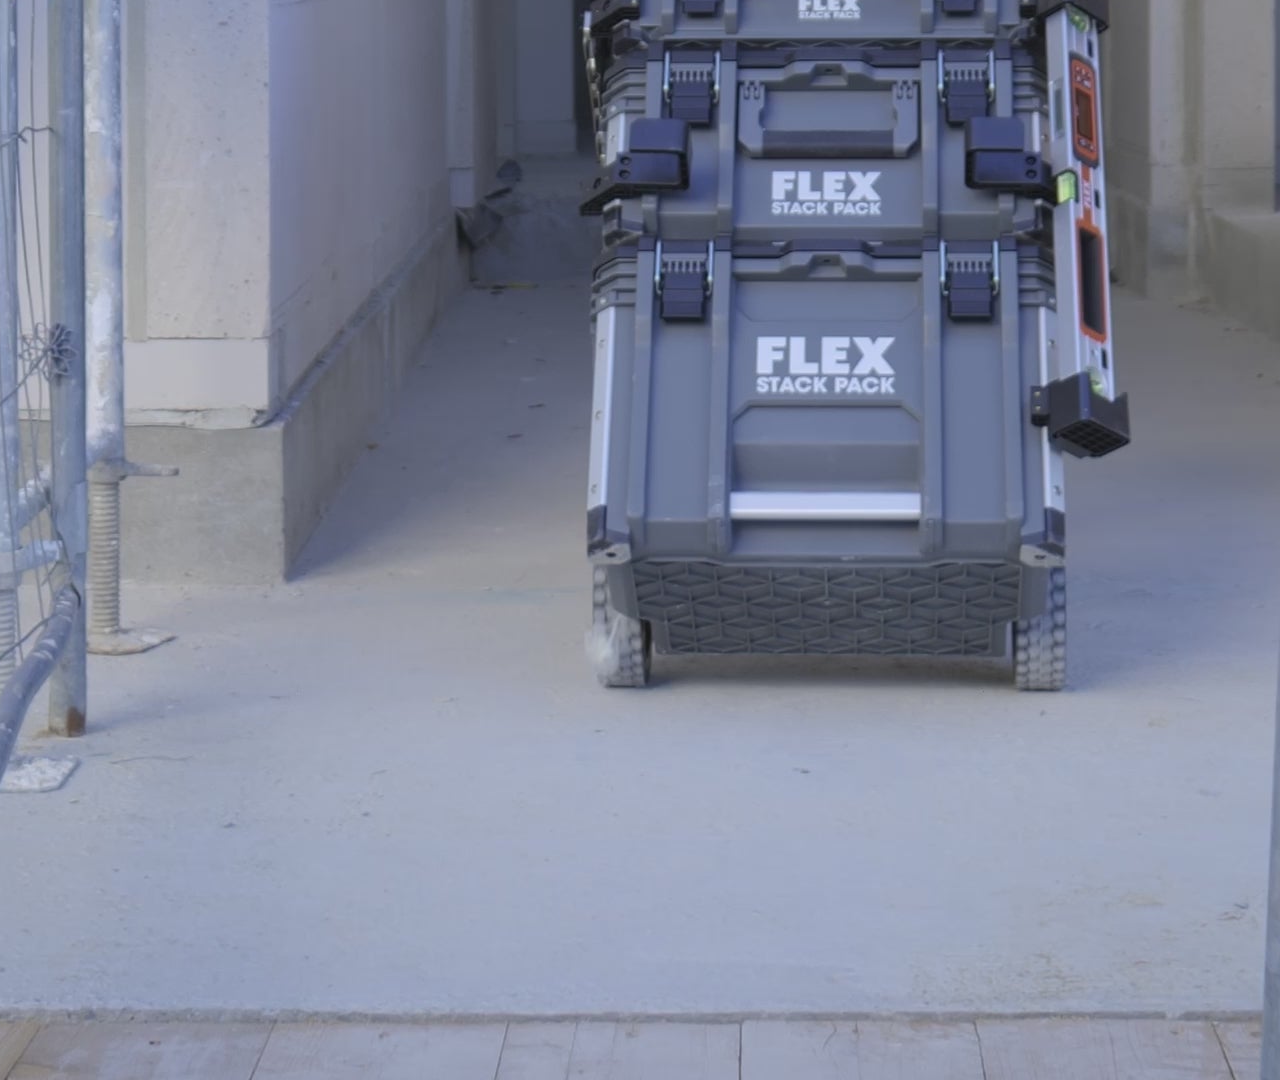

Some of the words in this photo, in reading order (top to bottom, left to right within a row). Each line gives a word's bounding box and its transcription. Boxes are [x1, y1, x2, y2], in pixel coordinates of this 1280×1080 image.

[772, 171, 881, 200] FLEX
[772, 201, 828, 215] STACK
[833, 201, 881, 215] PACK
[756, 336, 896, 374] FLEX
[756, 376, 827, 394] STACK
[834, 376, 895, 394] PACK
